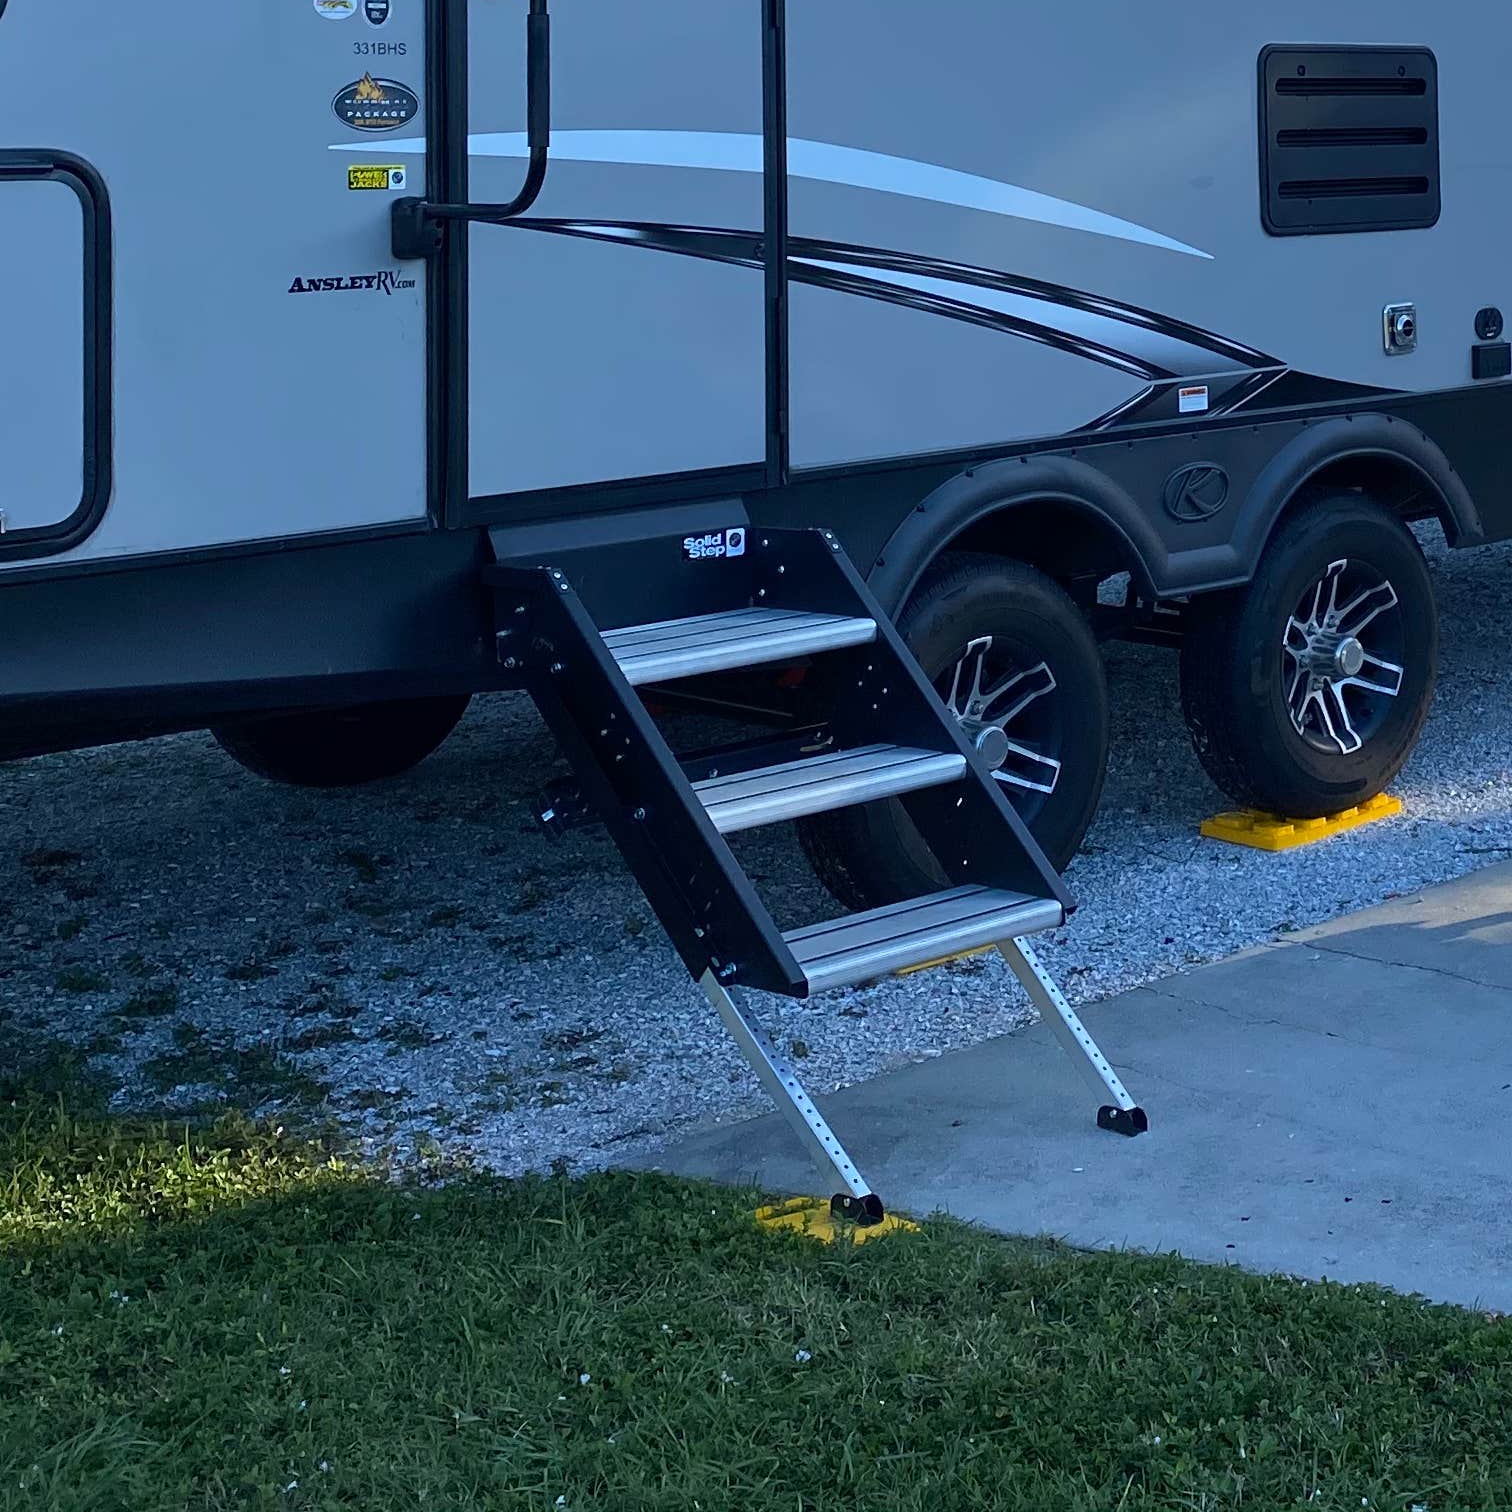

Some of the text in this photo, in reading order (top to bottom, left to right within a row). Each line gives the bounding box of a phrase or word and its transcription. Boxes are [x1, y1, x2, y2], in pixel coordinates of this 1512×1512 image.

[352, 41, 408, 56] 331BHS
[347, 110, 406, 118] PACKAGE
[683, 533, 722, 550] Solid
[688, 545, 726, 559] Step
